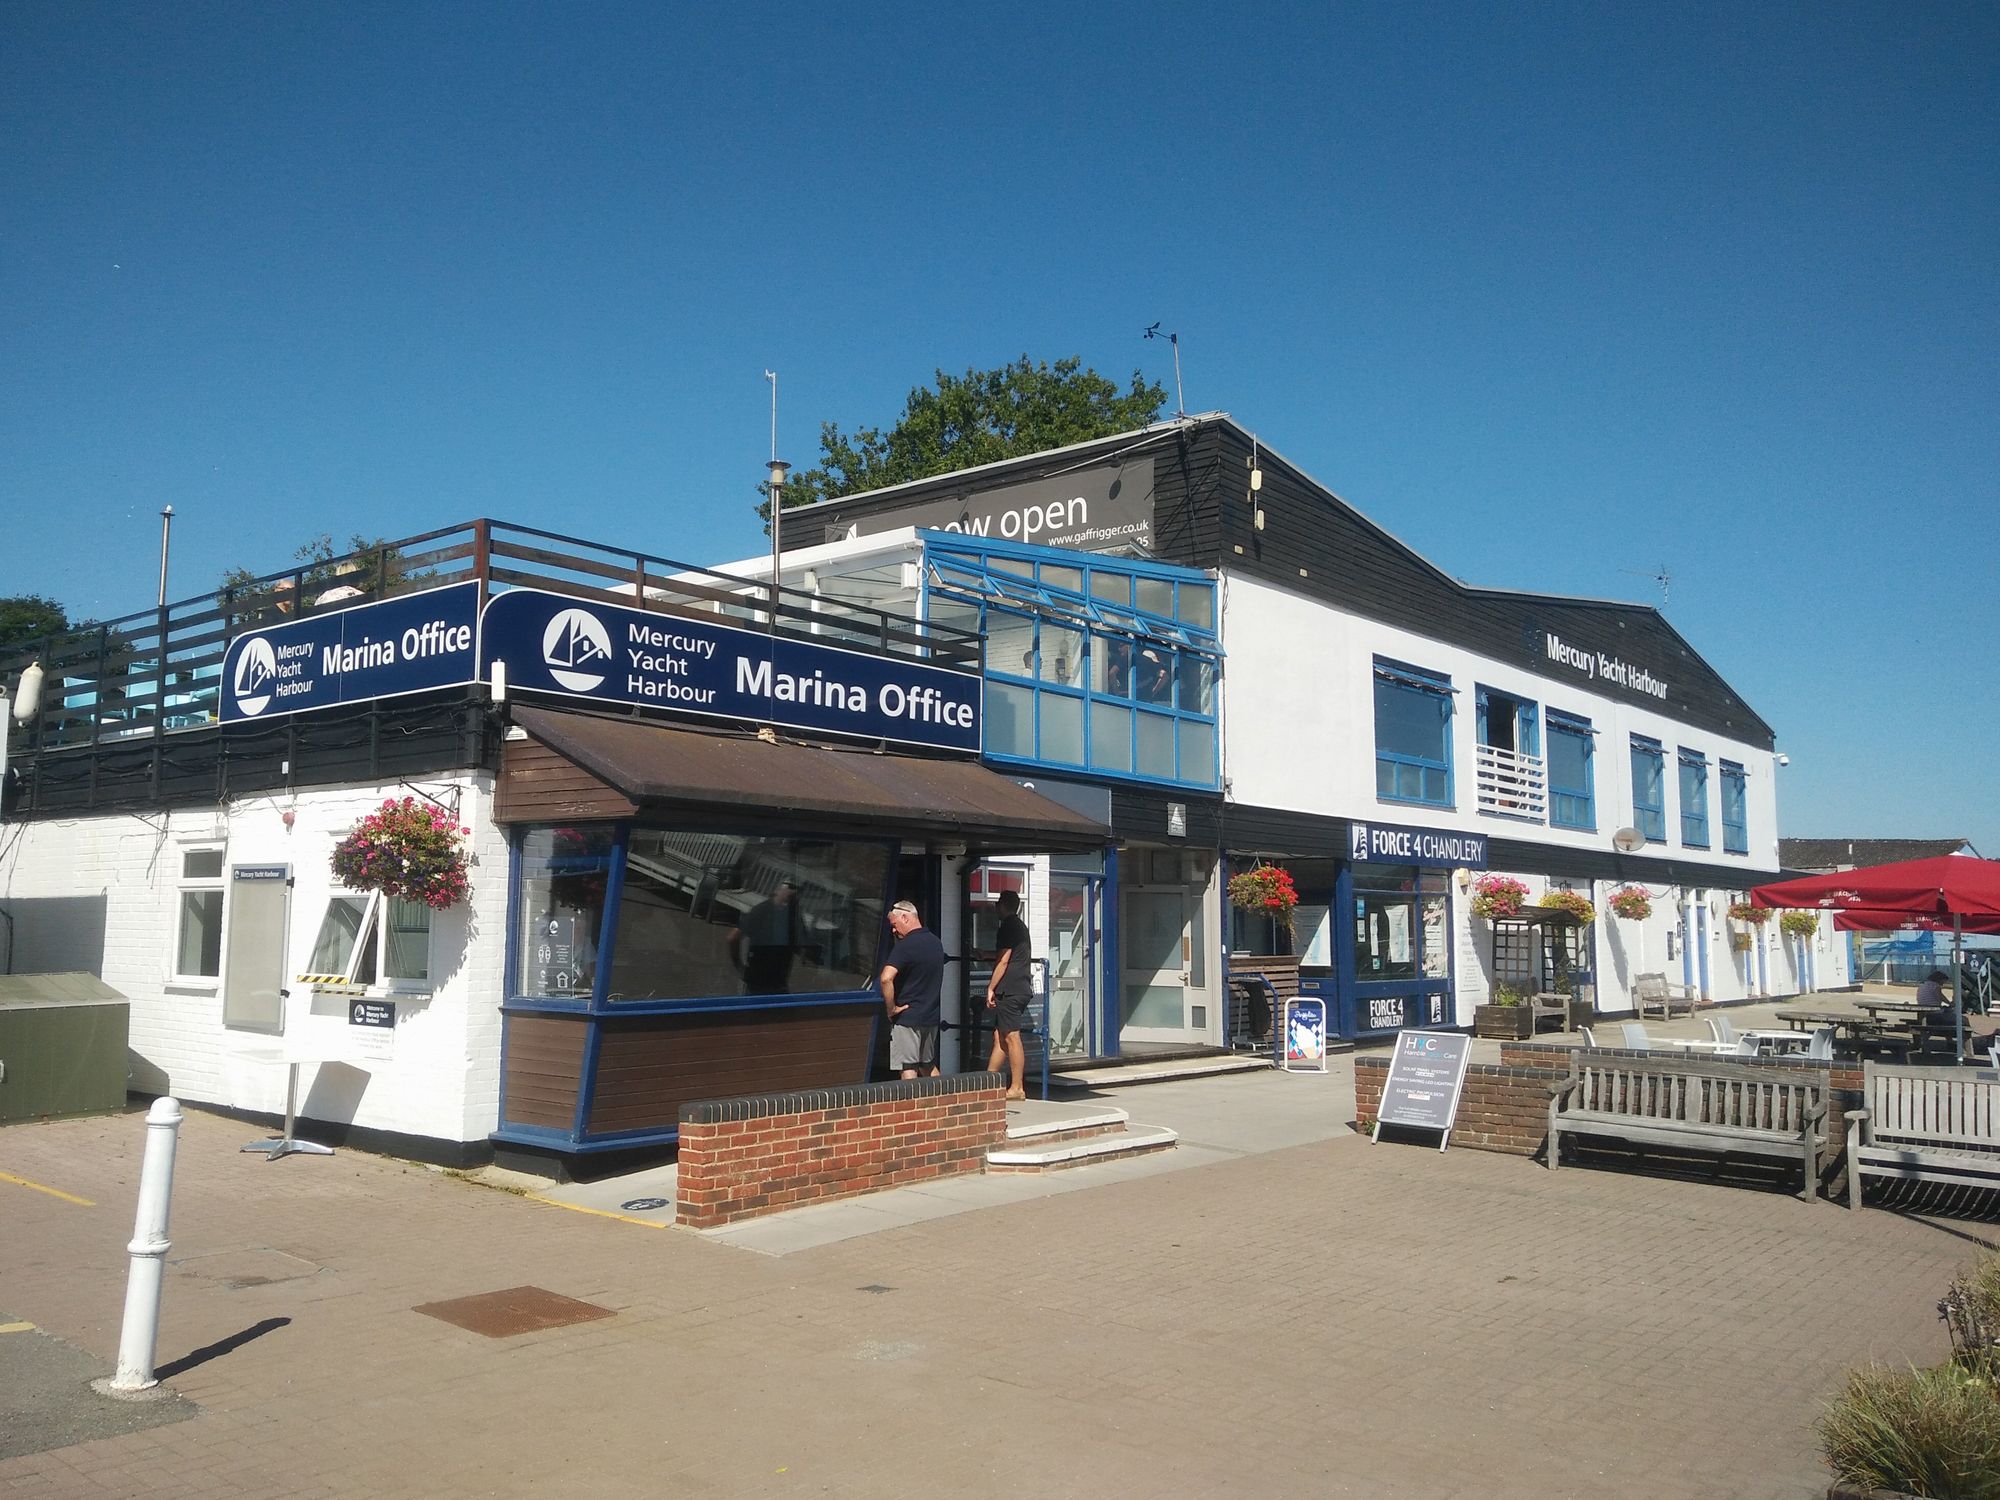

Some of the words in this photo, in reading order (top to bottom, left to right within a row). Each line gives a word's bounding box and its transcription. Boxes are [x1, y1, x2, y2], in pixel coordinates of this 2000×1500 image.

[1000, 496, 1087, 543] open
[1048, 519, 1149, 546] www.gaffrigger.co.uk
[277, 642, 314, 663] Mercury
[322, 637, 395, 676] Marina
[401, 621, 471, 661] Office
[628, 623, 716, 660] Mercury
[276, 661, 302, 679] Yacht
[627, 648, 688, 676] Yacht
[1547, 632, 1595, 679] Mercury
[1597, 651, 1627, 685] Yacht
[1628, 664, 1668, 700] Harbour
[276, 680, 313, 698] Harbour
[627, 674, 716, 704] Harbour
[736, 656, 867, 713] Marina
[879, 683, 974, 728] Office
[1372, 830, 1412, 857] FORCE
[1413, 834, 1421, 857] 4
[1423, 835, 1483, 862] CHANDLERY
[1369, 999, 1397, 1017] FORCE
[1397, 998, 1404, 1016] 4
[1370, 1014, 1404, 1029] CHANDLERY
